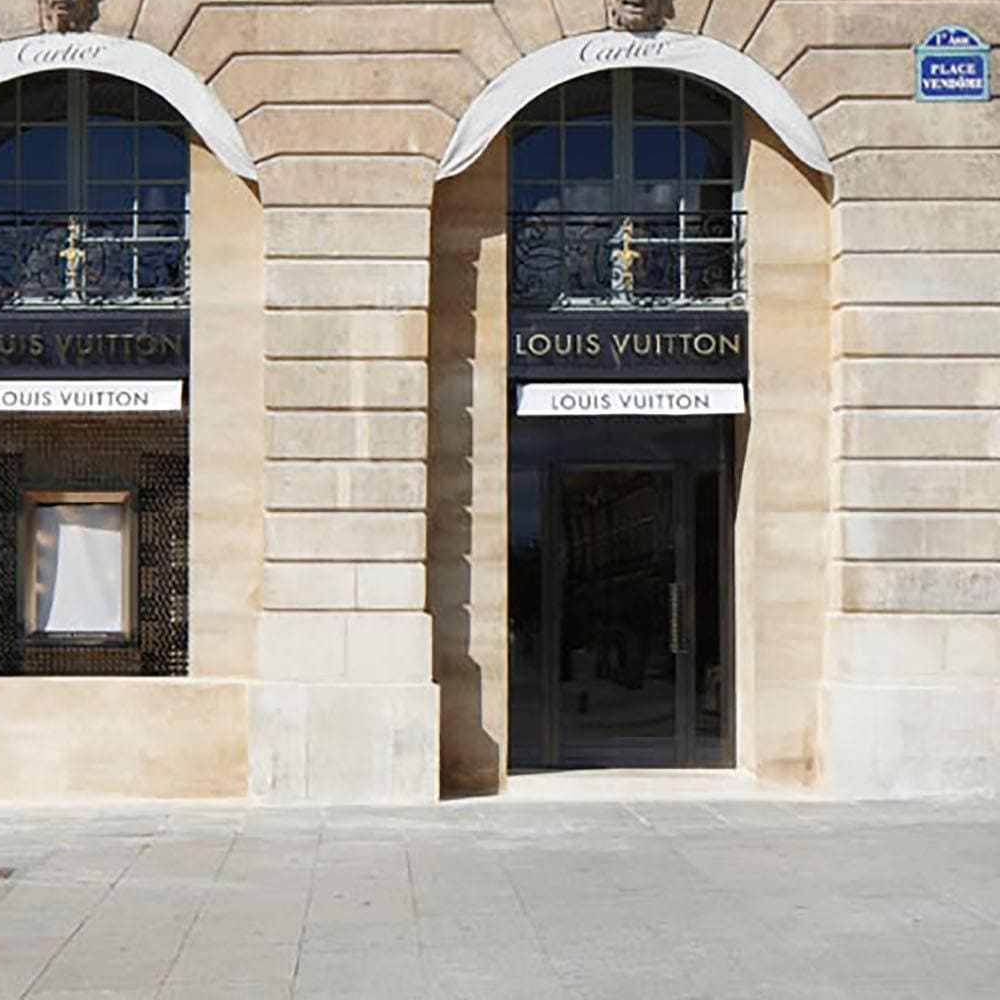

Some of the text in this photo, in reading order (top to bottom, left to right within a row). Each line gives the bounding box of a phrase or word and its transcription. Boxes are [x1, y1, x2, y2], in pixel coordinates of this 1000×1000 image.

[17, 42, 107, 63] Cartier
[579, 39, 670, 62] Cartier
[930, 63, 977, 75] PLACE
[54, 333, 183, 356] VUITTON
[516, 333, 741, 356] LOUIS VUITTON
[60, 391, 149, 406] VUITTON
[551, 393, 710, 411] LOUIS VUITTON
